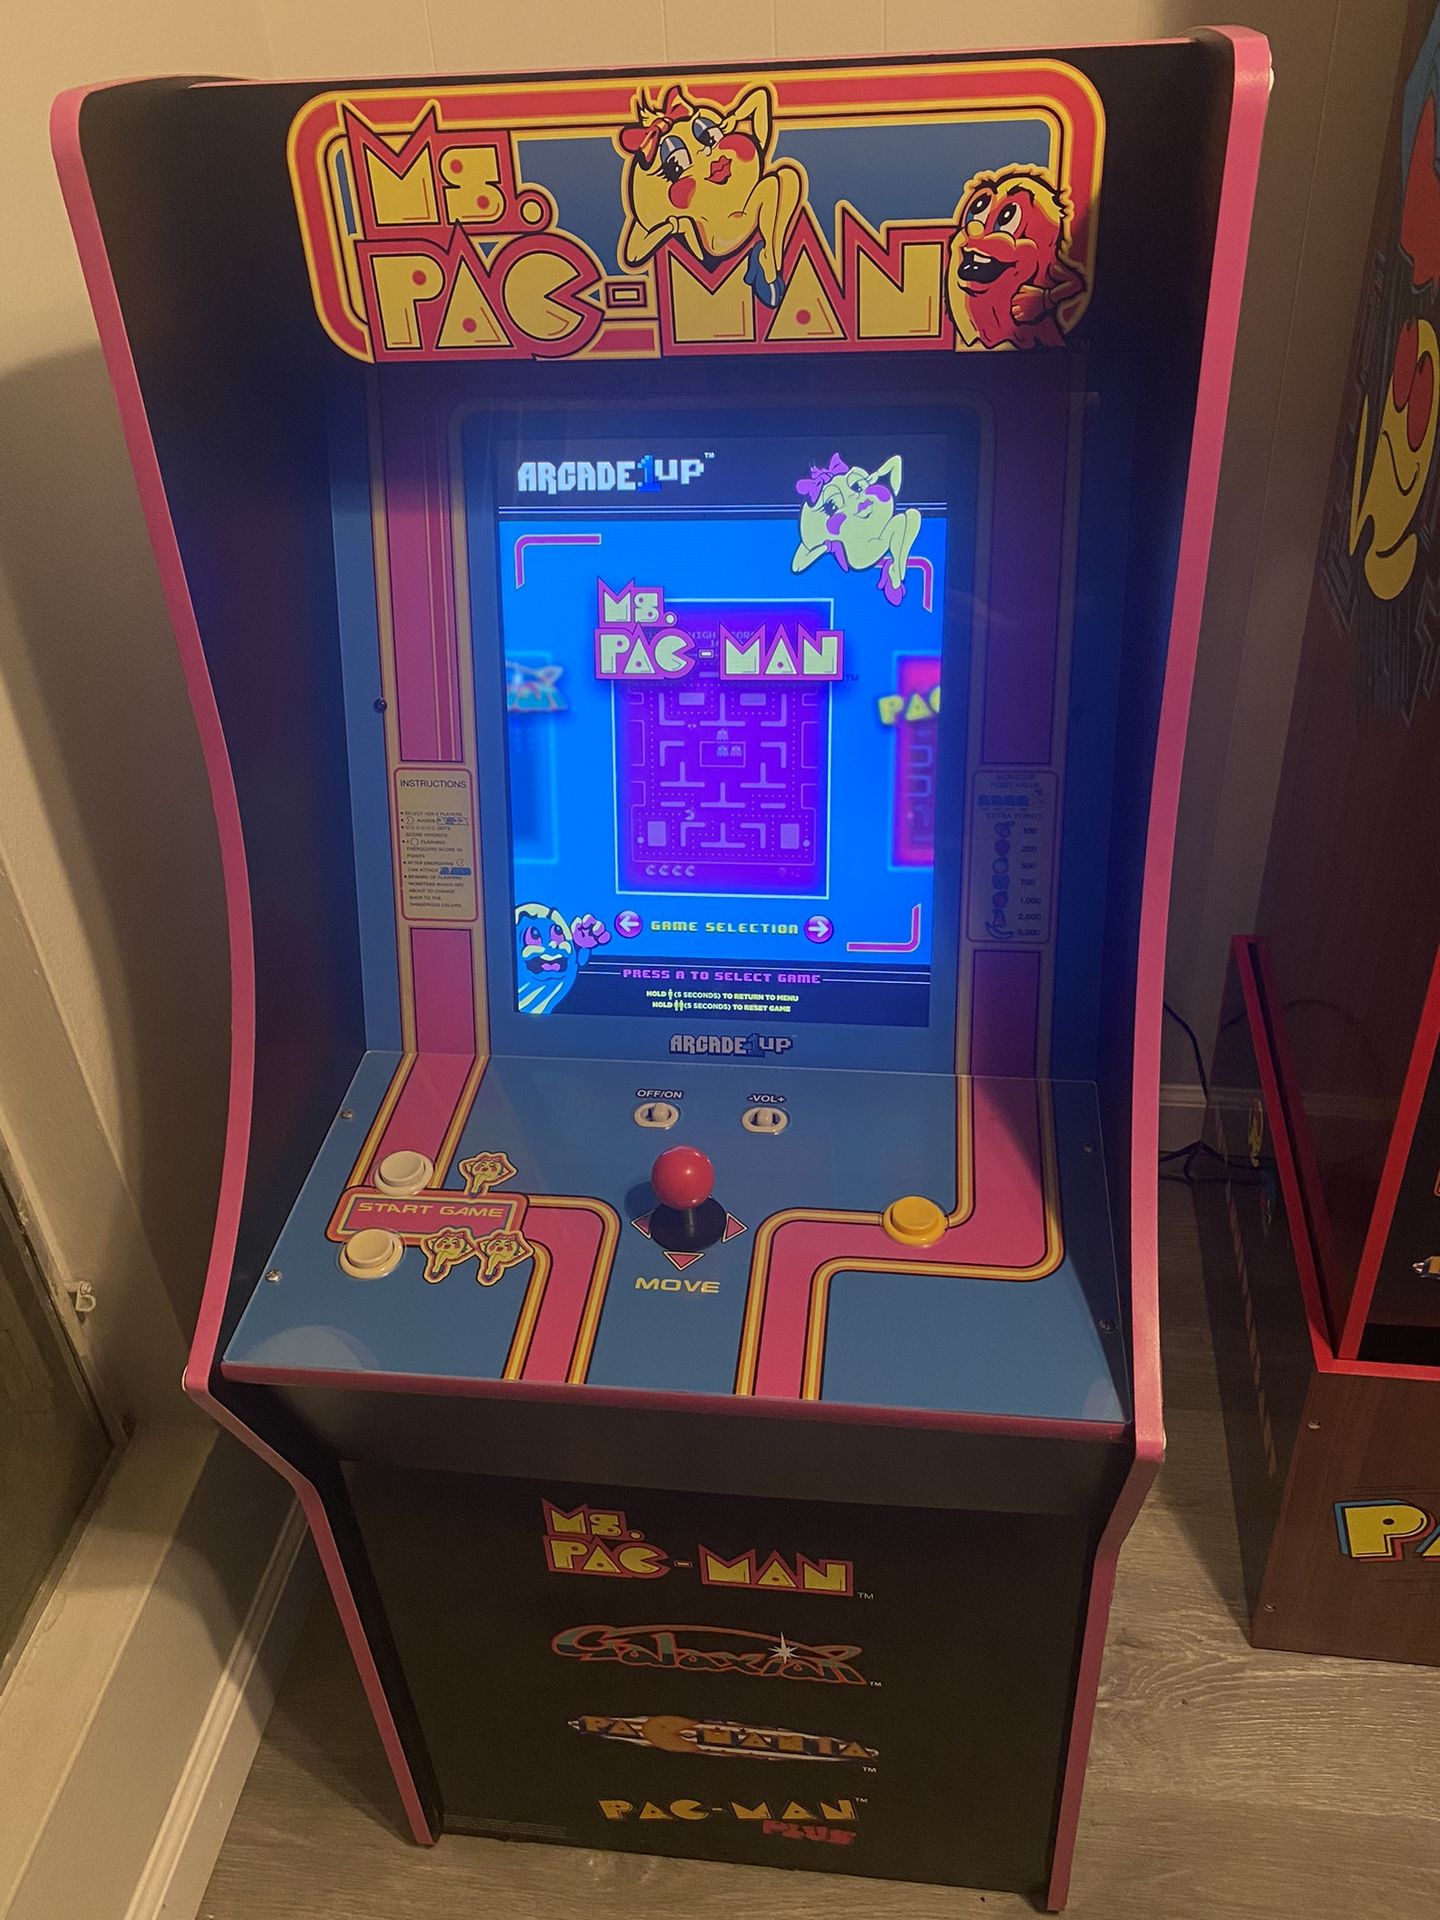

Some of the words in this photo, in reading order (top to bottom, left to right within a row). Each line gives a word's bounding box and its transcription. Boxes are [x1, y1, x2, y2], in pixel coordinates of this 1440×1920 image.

[342, 103, 552, 234] MS.
[358, 203, 957, 357] PAC-MAN
[597, 577, 679, 628] MS.
[594, 623, 845, 681] PAC-MAN
[400, 779, 467, 788] INSTRUCTIONS
[651, 920, 698, 932] GAME
[705, 922, 798, 935] SELECTION
[623, 969, 671, 980] PRESS
[676, 970, 685, 980] A
[690, 971, 709, 981] TO
[715, 971, 771, 983] SELECT
[778, 973, 821, 984] GAME
[646, 990, 667, 998] HOLD
[683, 991, 721, 999] SECONDS)
[734, 993, 764, 1001] RETURN
[777, 994, 799, 1002] MENU
[652, 1001, 673, 1009] HOLD
[693, 1003, 731, 1011] SECONDS)
[744, 1004, 768, 1012] RESET
[636, 1088, 683, 1101] OFF/ON
[357, 1201, 435, 1216] START
[439, 1204, 504, 1218] GAME
[634, 1276, 720, 1294] MOVE
[542, 1498, 644, 1541] MS.
[543, 1534, 854, 1597] PAC-MAN
[858, 1591, 875, 1600] TM
[598, 1799, 857, 1820] PAC-MAN
